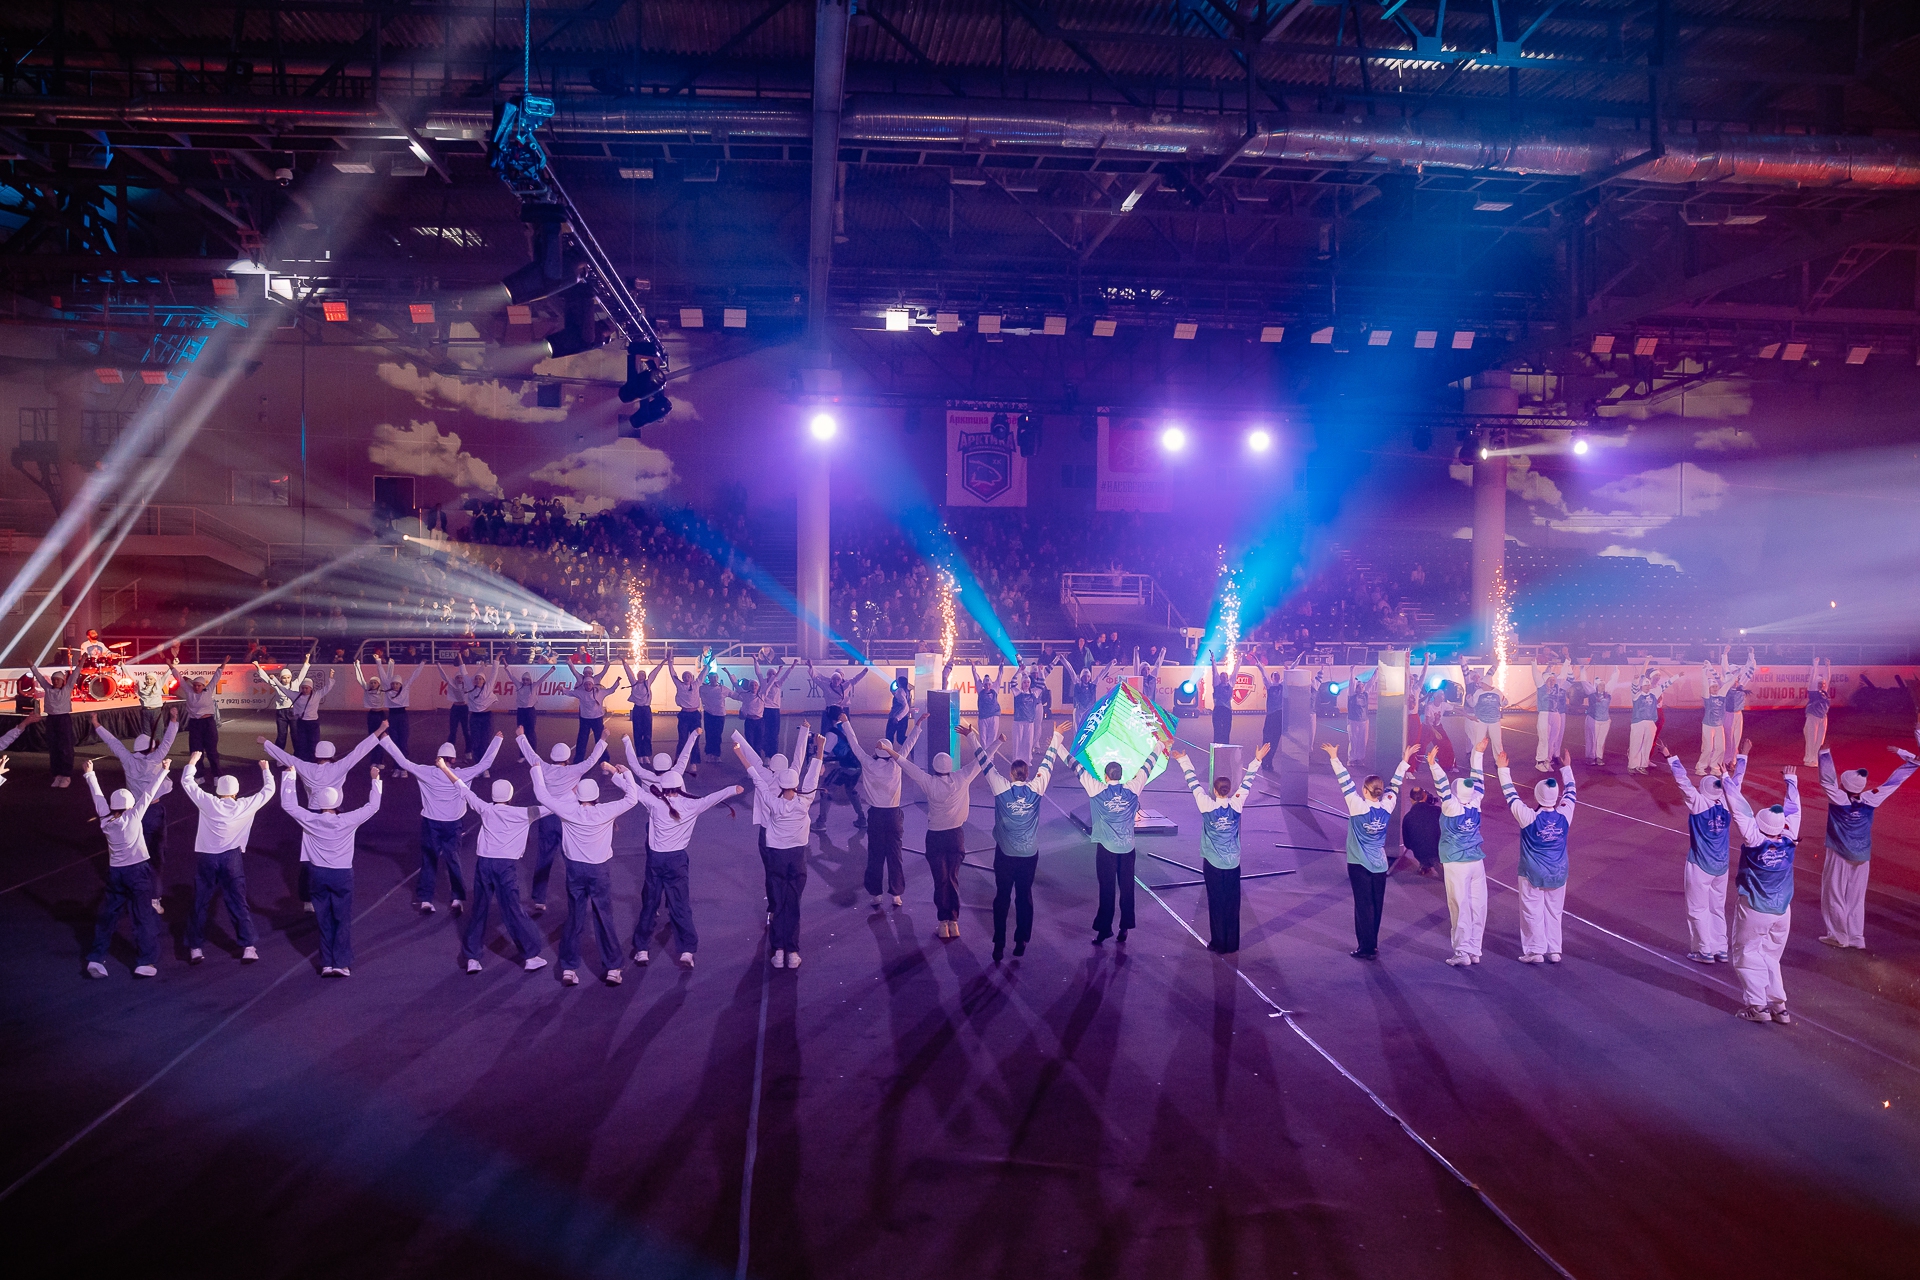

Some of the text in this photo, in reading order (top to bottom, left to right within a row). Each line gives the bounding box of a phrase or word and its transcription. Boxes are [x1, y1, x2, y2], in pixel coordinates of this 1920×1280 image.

[949, 414, 989, 425] Арктика
[1750, 673, 1849, 684] ОККЕЙ НАЧИНАЕ ДЕСЬ
